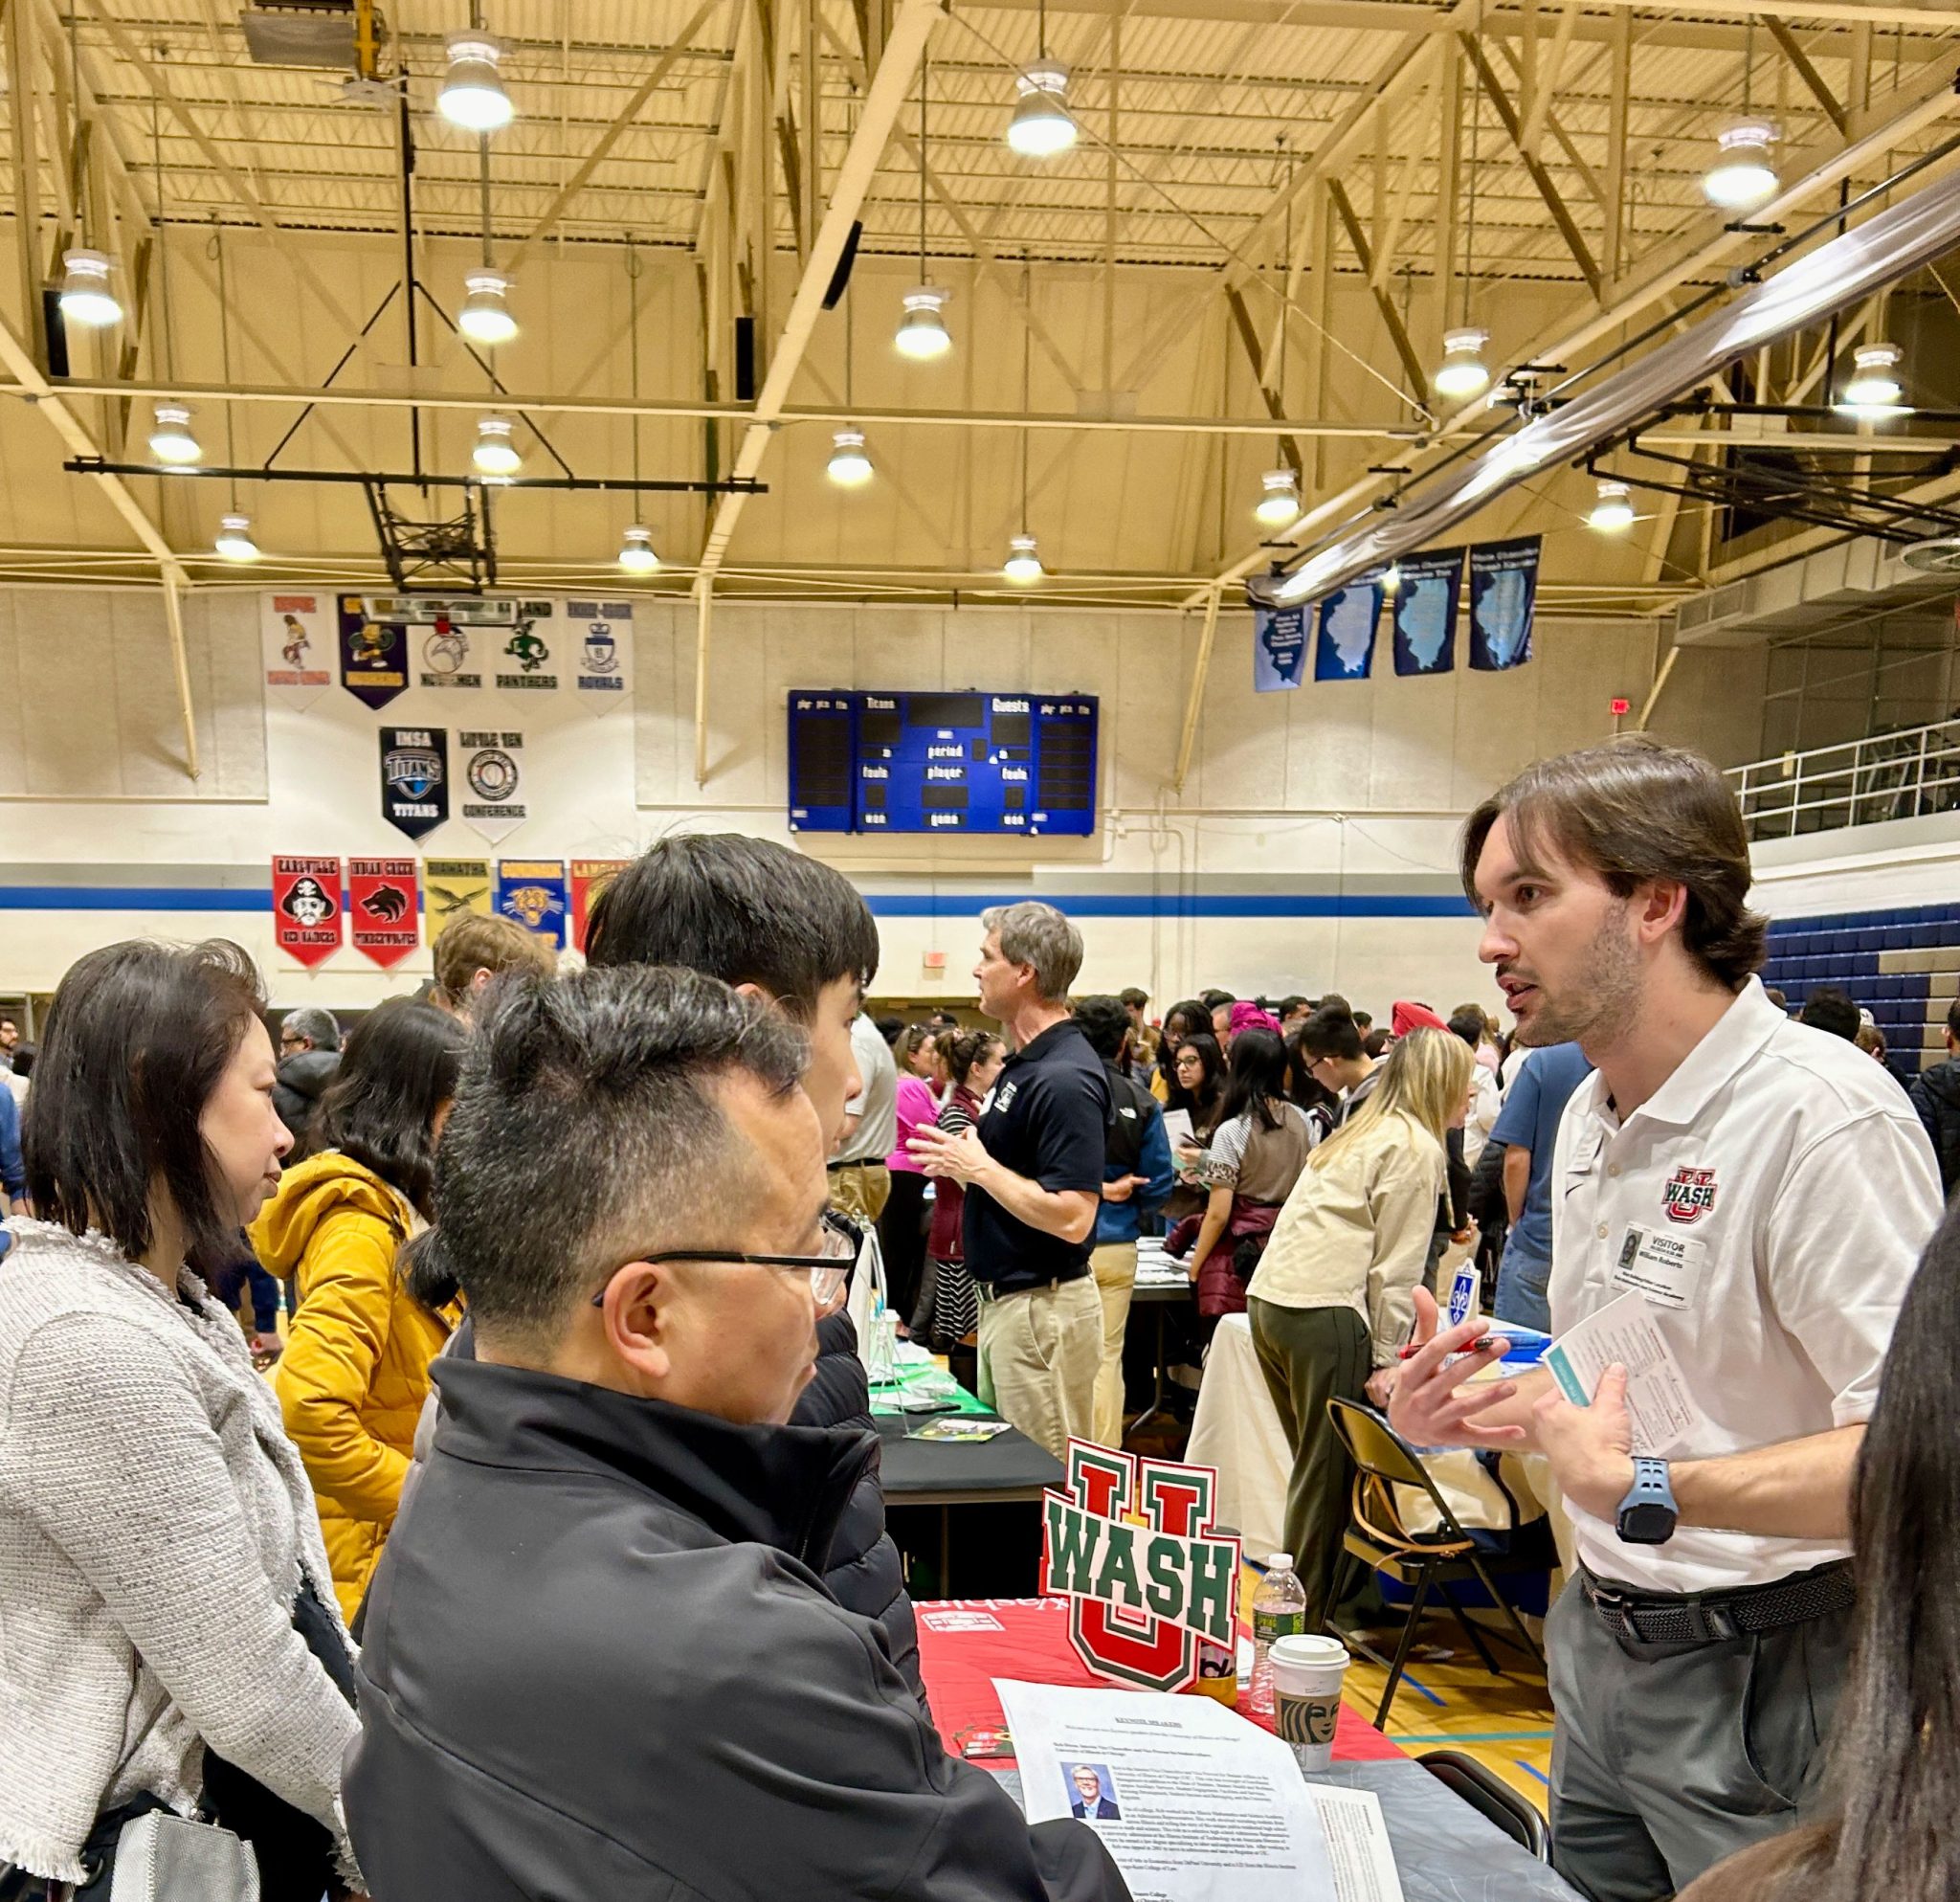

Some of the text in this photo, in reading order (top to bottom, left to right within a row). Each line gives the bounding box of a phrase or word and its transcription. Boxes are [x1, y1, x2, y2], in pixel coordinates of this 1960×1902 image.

[992, 698, 1030, 713] Guests
[395, 731, 433, 746] IMSA
[927, 745, 964, 759] period
[862, 766, 889, 779] fouls
[927, 767, 964, 780] player
[1002, 767, 1028, 781] fouls
[392, 804, 439, 817] TITANS
[1665, 1183, 1714, 1207] WASH
[1653, 1236, 1685, 1252] VISITOR
[1659, 1256, 1683, 1269] Roberts
[1047, 1501, 1235, 1645] WASH
[1070, 1445, 1212, 1694] U
